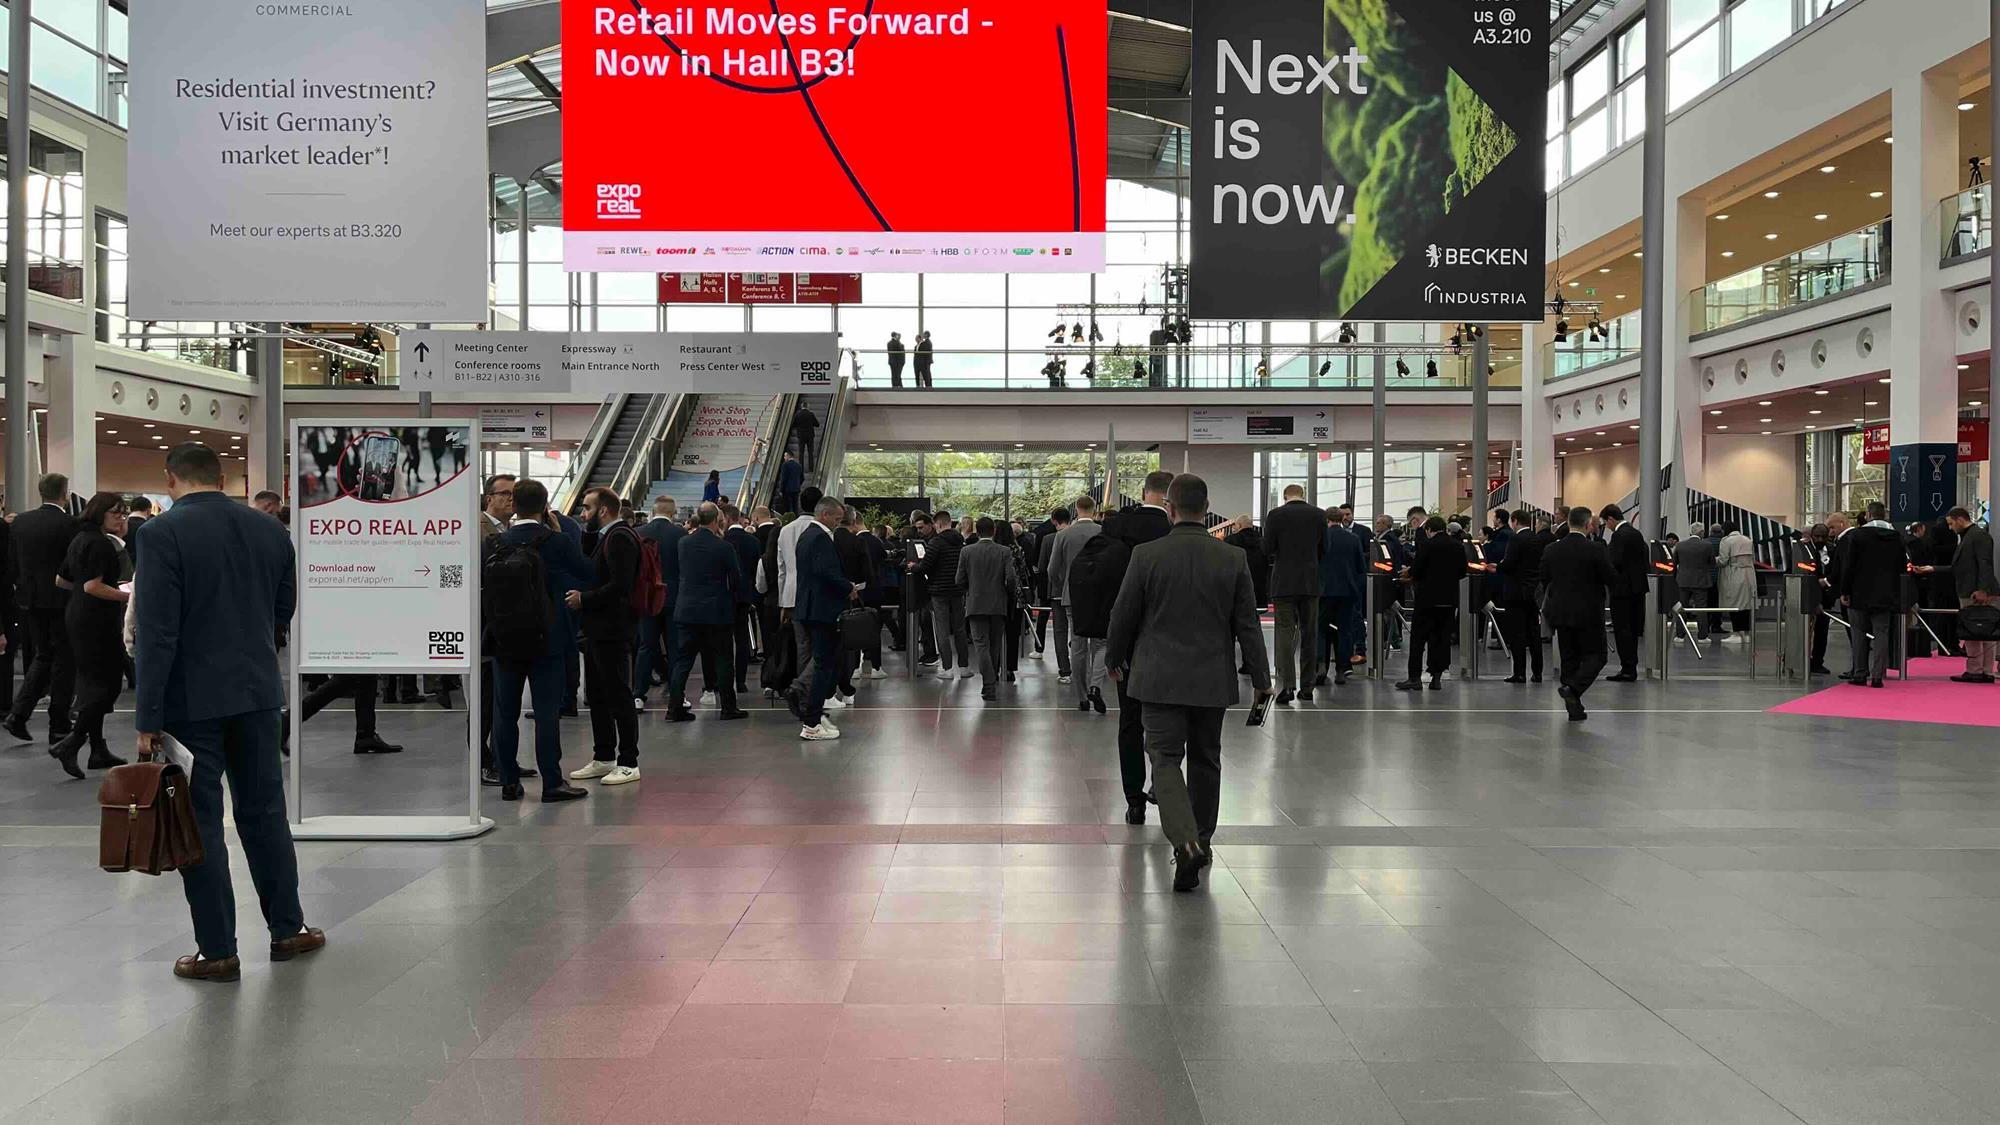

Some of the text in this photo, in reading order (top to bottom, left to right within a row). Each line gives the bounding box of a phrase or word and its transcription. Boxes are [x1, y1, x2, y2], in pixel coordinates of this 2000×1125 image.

[255, 5, 353, 16] COMMERCIAL
[1474, 8, 1516, 25] us @
[595, 8, 694, 35] Retail
[705, 9, 817, 35] Moves
[828, 8, 970, 35] Forward
[1473, 28, 1531, 44] A3.210
[595, 48, 855, 76] Now in Hall B3!
[1216, 39, 1368, 94] Next
[176, 79, 435, 99] Residential investment?
[219, 112, 268, 131] Visit
[1214, 106, 1261, 160] is
[221, 146, 300, 165] market
[597, 184, 641, 202] expo
[1213, 184, 1356, 224] now.
[210, 224, 402, 241] Meet our experts at B3.320
[761, 247, 794, 255] ACTION
[800, 247, 830, 255] cima.
[1446, 249, 1527, 265] BECKEN
[1439, 292, 1527, 304] INDUSTRIA
[455, 343, 529, 354] Meeting Center
[561, 345, 617, 355] Expressway
[680, 345, 732, 354] Restaurant
[455, 360, 509, 370] Conference
[561, 362, 660, 371] Main Entrance North
[680, 363, 765, 371] Press Center West
[800, 361, 831, 372] expo
[701, 406, 751, 416] Next Step
[697, 417, 747, 426] Expo Real
[692, 428, 753, 437] Asia Pacific
[309, 520, 462, 535] EXPO REAL APP
[309, 564, 354, 573] Download
[429, 631, 464, 648] expo
